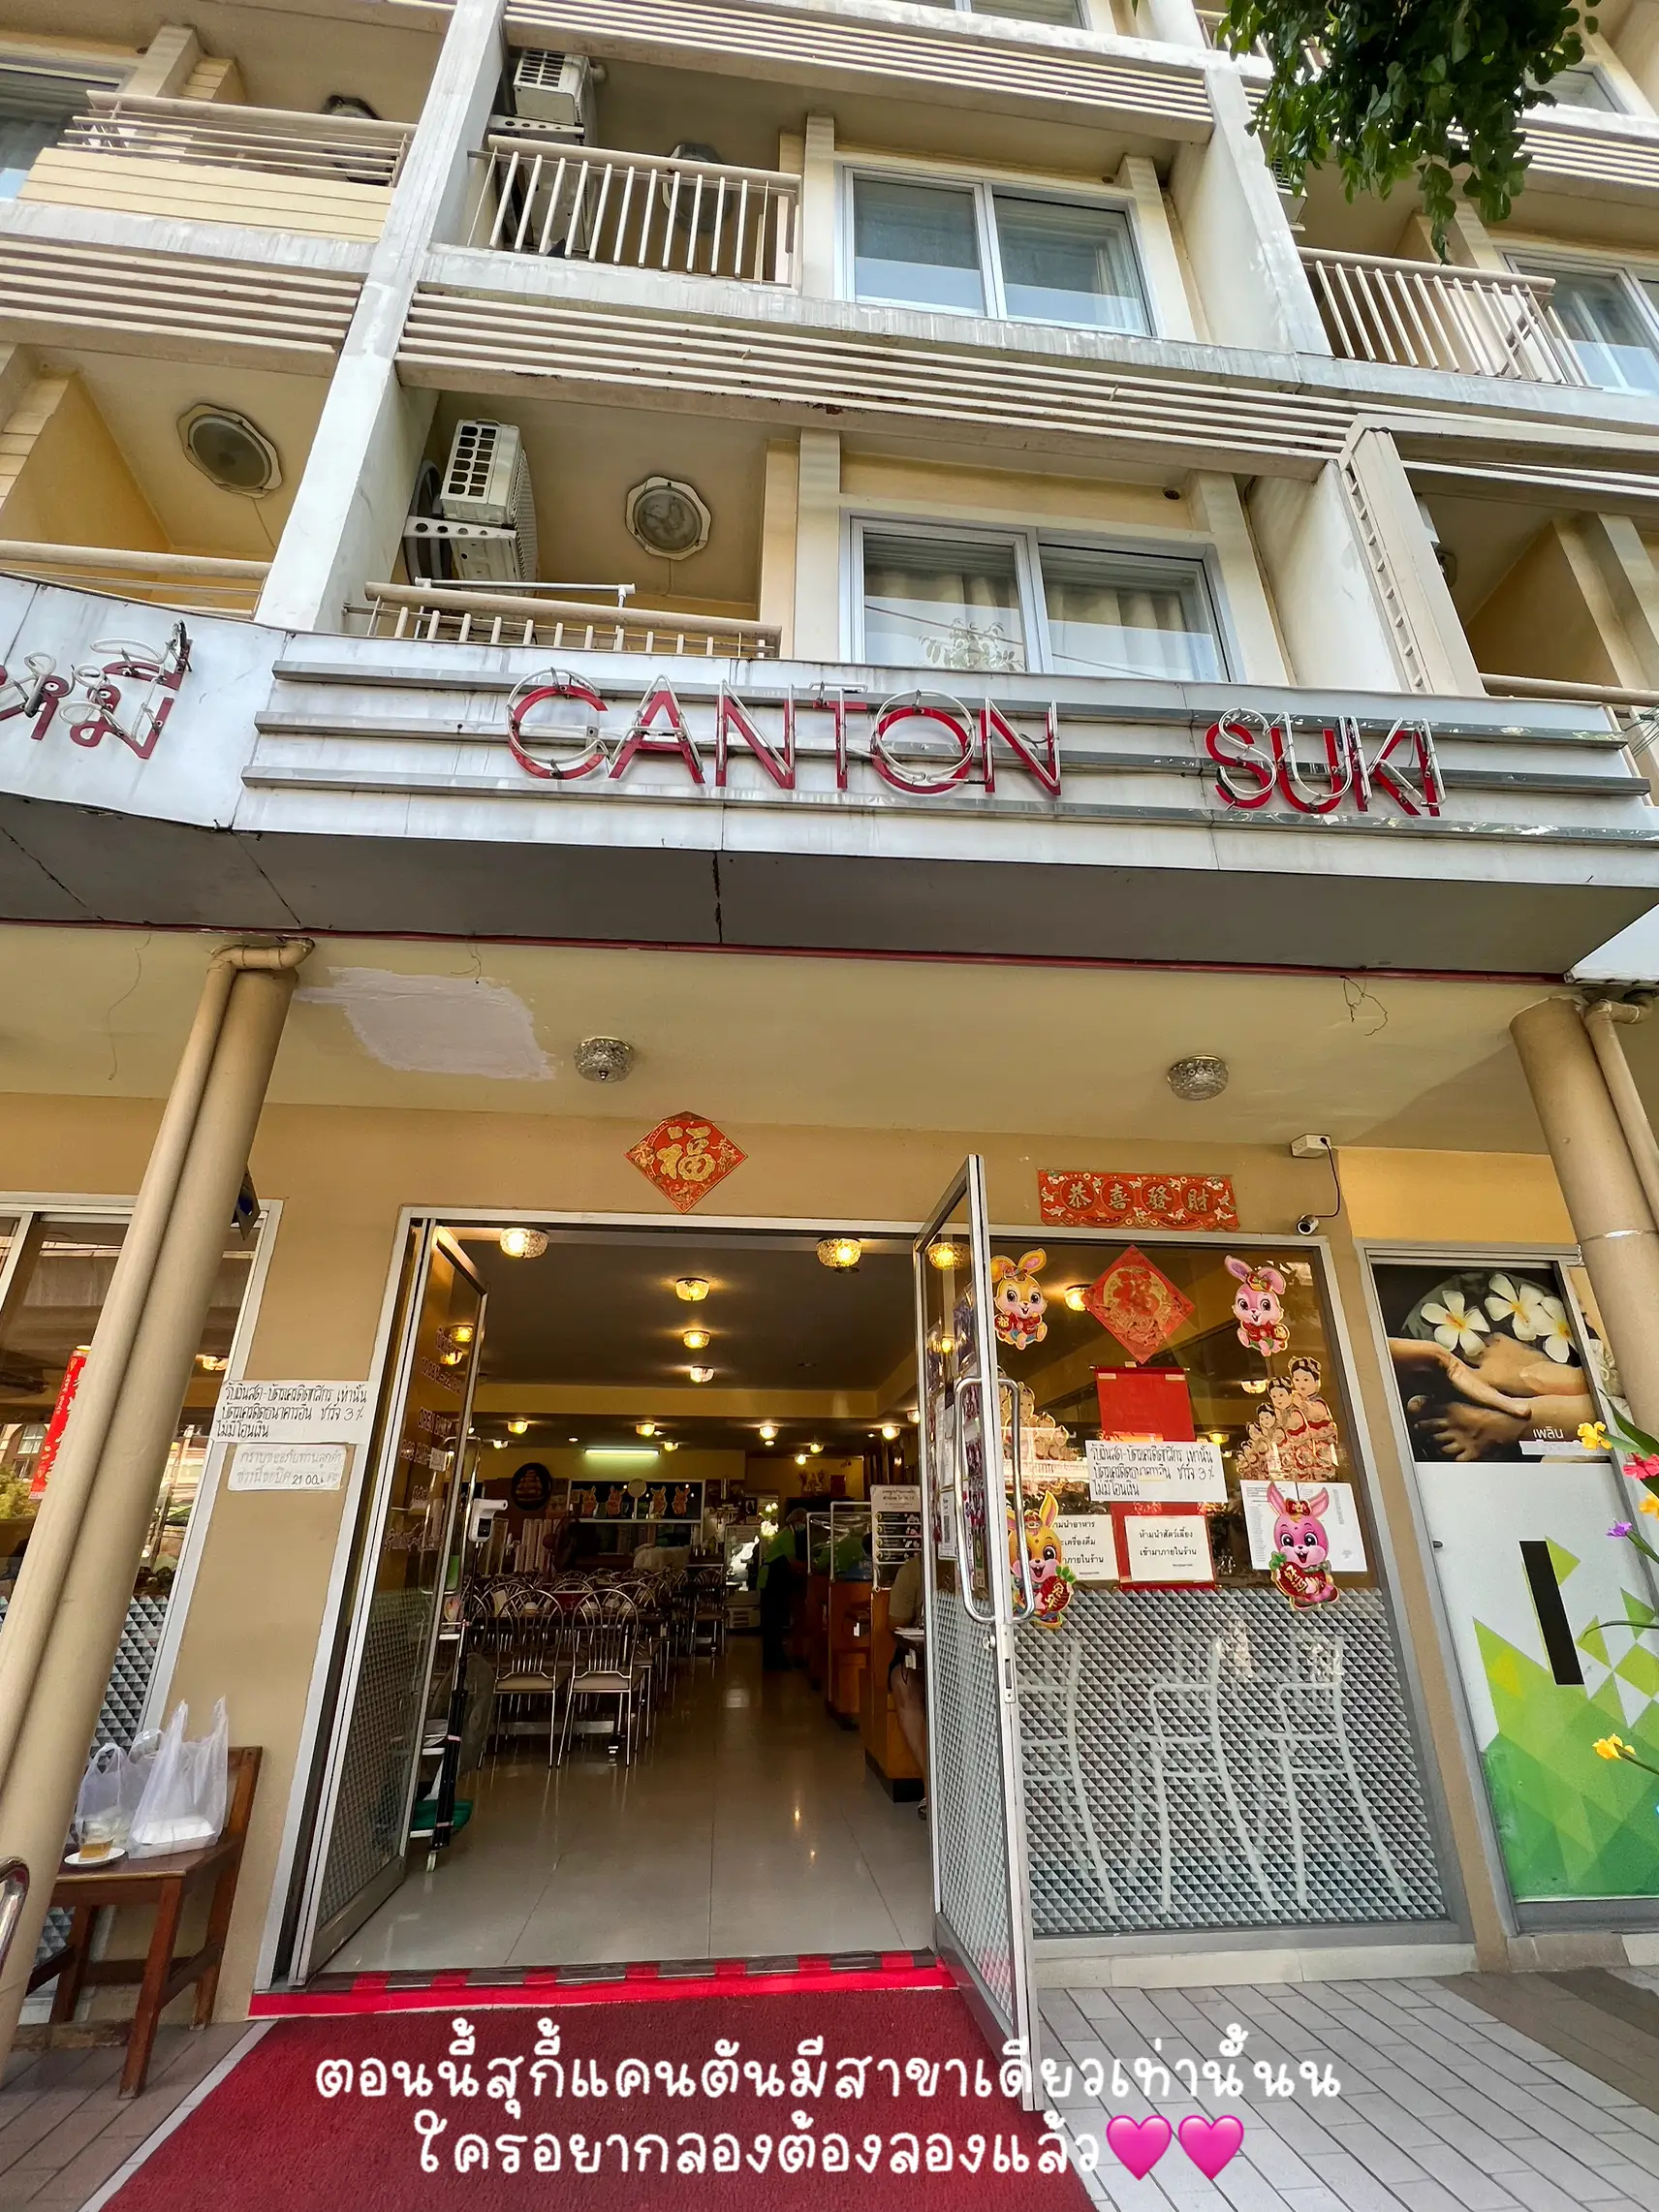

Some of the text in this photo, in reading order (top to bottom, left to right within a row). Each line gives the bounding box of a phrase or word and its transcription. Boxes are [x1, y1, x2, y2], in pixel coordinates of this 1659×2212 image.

[507, 669, 1447, 817] CANTON SUKI
[656, 1126, 716, 1182] 福
[1068, 1181, 1209, 1212] 恭喜發財
[1532, 1425, 1565, 1439] เพลิน
[1140, 1545, 1197, 1557] เข้ามาภายในร้าน
